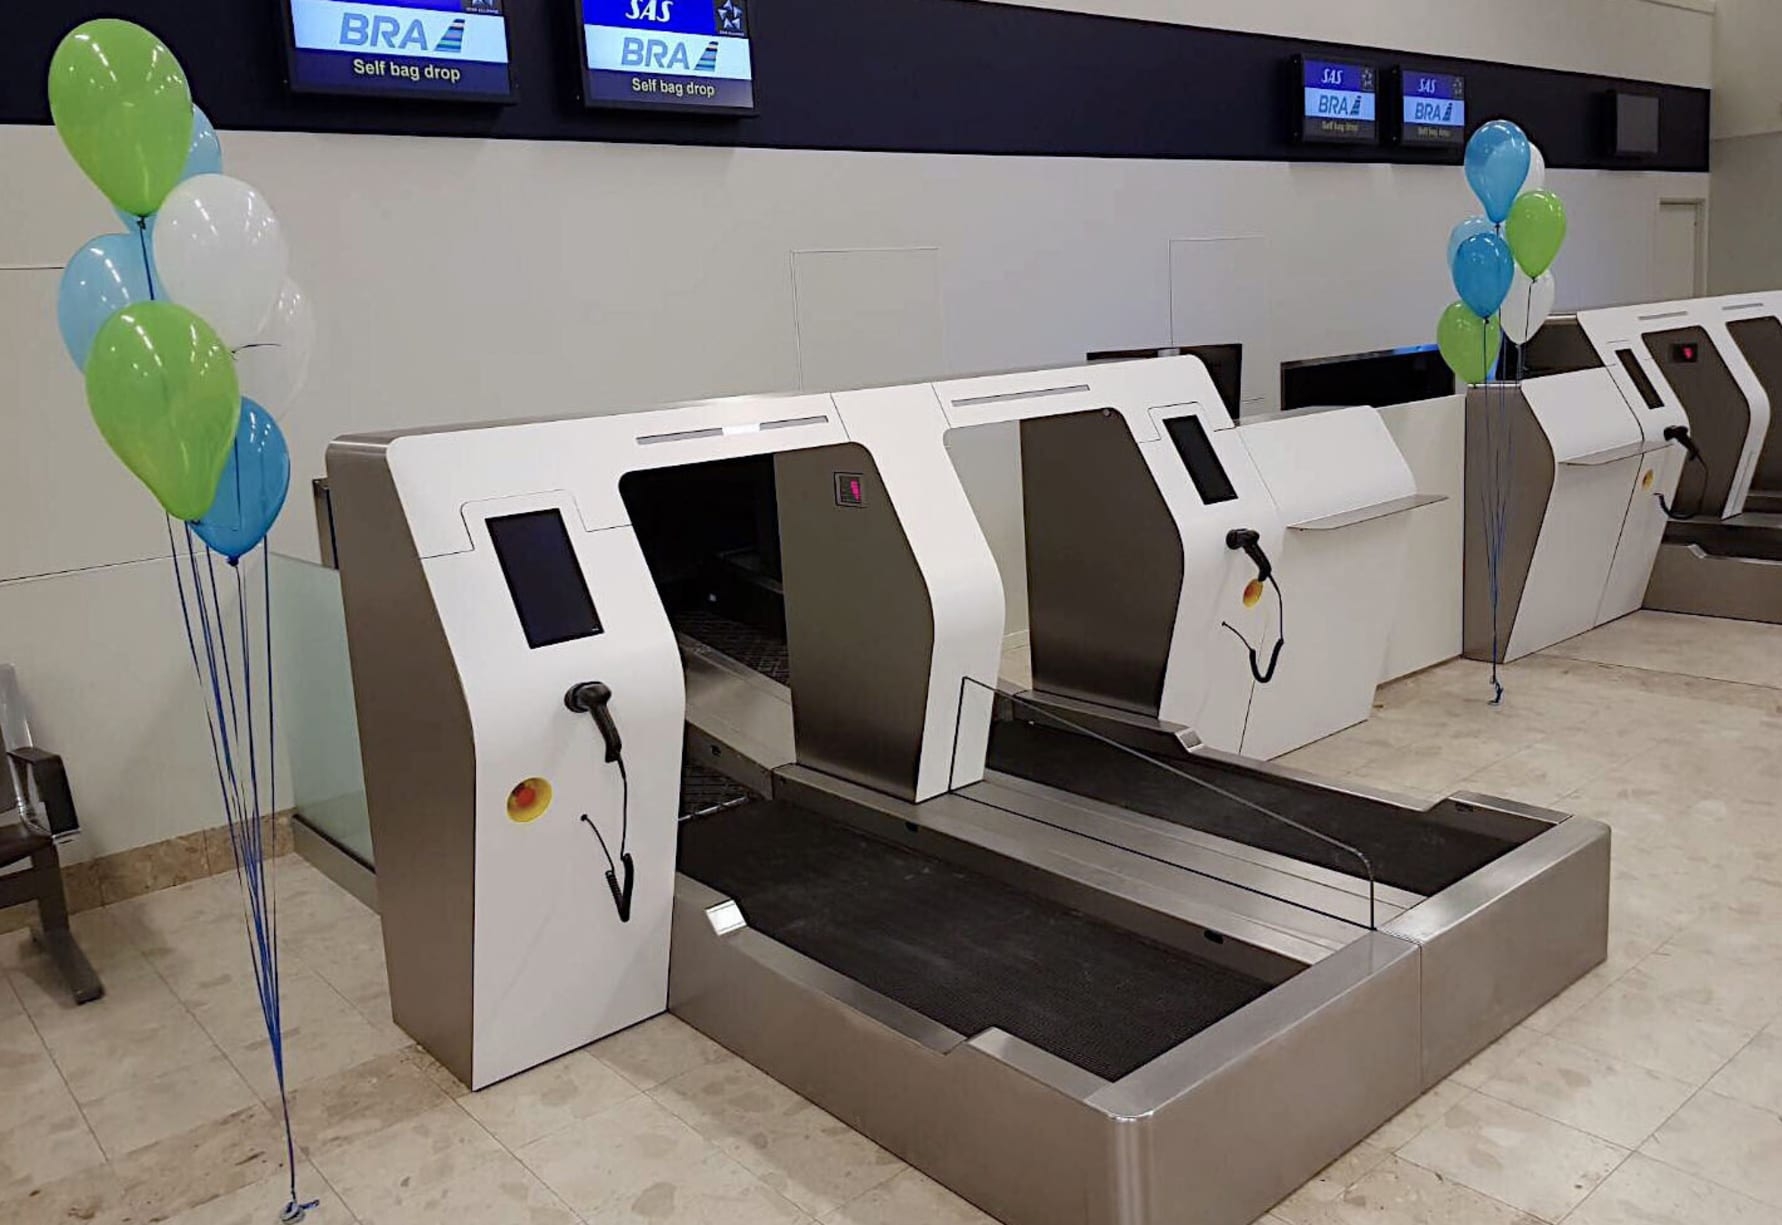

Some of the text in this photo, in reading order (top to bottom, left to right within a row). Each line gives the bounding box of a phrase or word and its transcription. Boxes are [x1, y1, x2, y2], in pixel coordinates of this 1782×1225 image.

[625, 0, 674, 22] SAS
[339, 12, 428, 50] BRA
[621, 37, 690, 70] BRA
[353, 58, 461, 84] Self bag drop
[1321, 68, 1344, 85] SAS
[632, 77, 716, 98] Self bag drop
[1418, 78, 1437, 94] SAS
[1318, 95, 1348, 115] BRA
[1415, 102, 1441, 121] BRA
